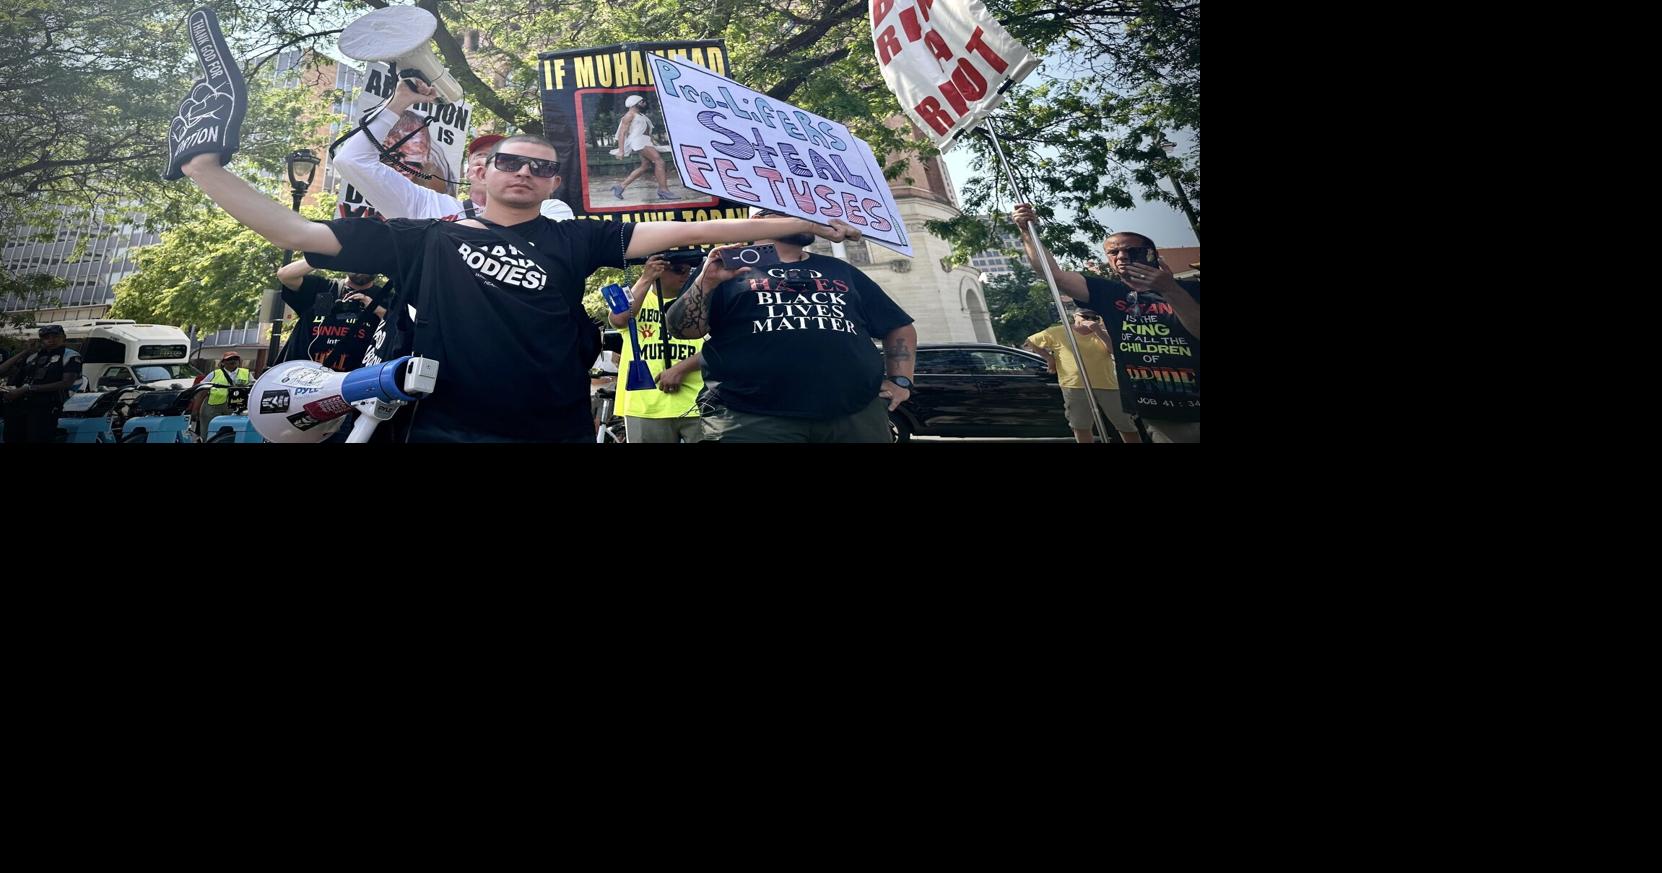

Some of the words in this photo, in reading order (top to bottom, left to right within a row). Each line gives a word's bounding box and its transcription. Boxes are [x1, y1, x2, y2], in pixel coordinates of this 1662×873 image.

[192, 18, 206, 47] THANK
[202, 42, 216, 64] GOD
[924, 28, 954, 73] A
[207, 60, 224, 80] FOR
[544, 58, 566, 91] IF
[914, 25, 1009, 137] RIOT
[437, 127, 454, 146] IS
[680, 144, 892, 232] FETUSES
[750, 278, 849, 293] HAES
[757, 291, 847, 306] BLACK
[767, 304, 845, 319] LIVES
[1126, 314, 1137, 323] IS
[1141, 315, 1158, 323] THE
[312, 325, 366, 339] SINNES
[752, 316, 858, 336] MATTER
[1122, 320, 1170, 336] KING
[1121, 333, 1133, 341] OF
[1135, 335, 1160, 343] ALL
[1161, 337, 1188, 345] THE
[1120, 342, 1192, 357] CHILDREN
[1143, 354, 1160, 363] OF
[1137, 397, 1158, 406] JOB
[1163, 399, 1174, 408] 41
